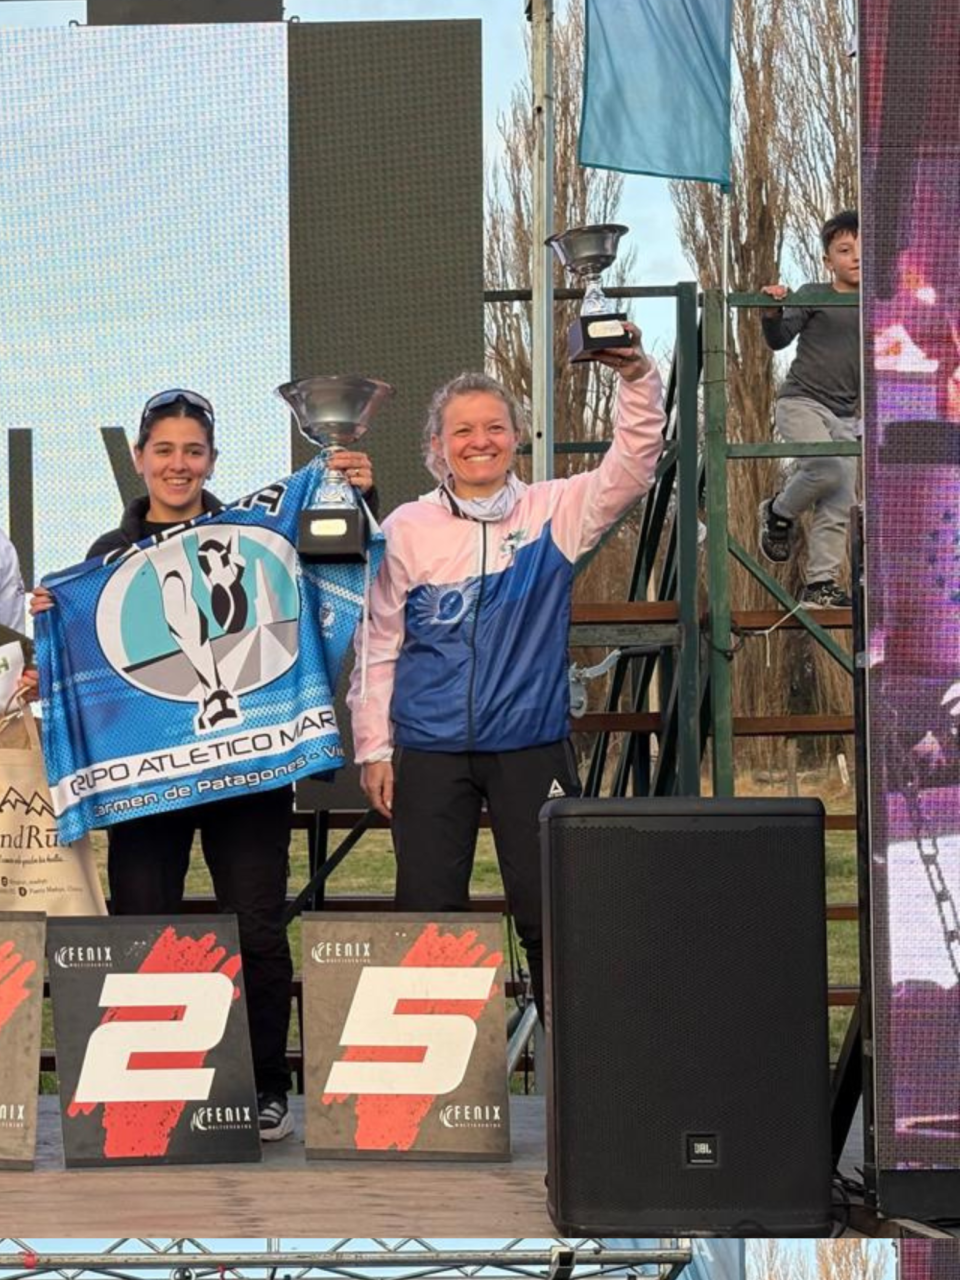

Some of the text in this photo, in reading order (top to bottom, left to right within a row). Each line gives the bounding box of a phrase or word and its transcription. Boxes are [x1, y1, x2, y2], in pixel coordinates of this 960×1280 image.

[165, 783, 192, 800] de
[197, 757, 306, 792] Patagones
[68, 947, 112, 962] FENIX
[326, 942, 370, 957] FENIX
[75, 973, 234, 1102] 2
[324, 967, 496, 1094] 5
[206, 1107, 251, 1123] FENIX
[454, 1105, 500, 1120] FENIX
